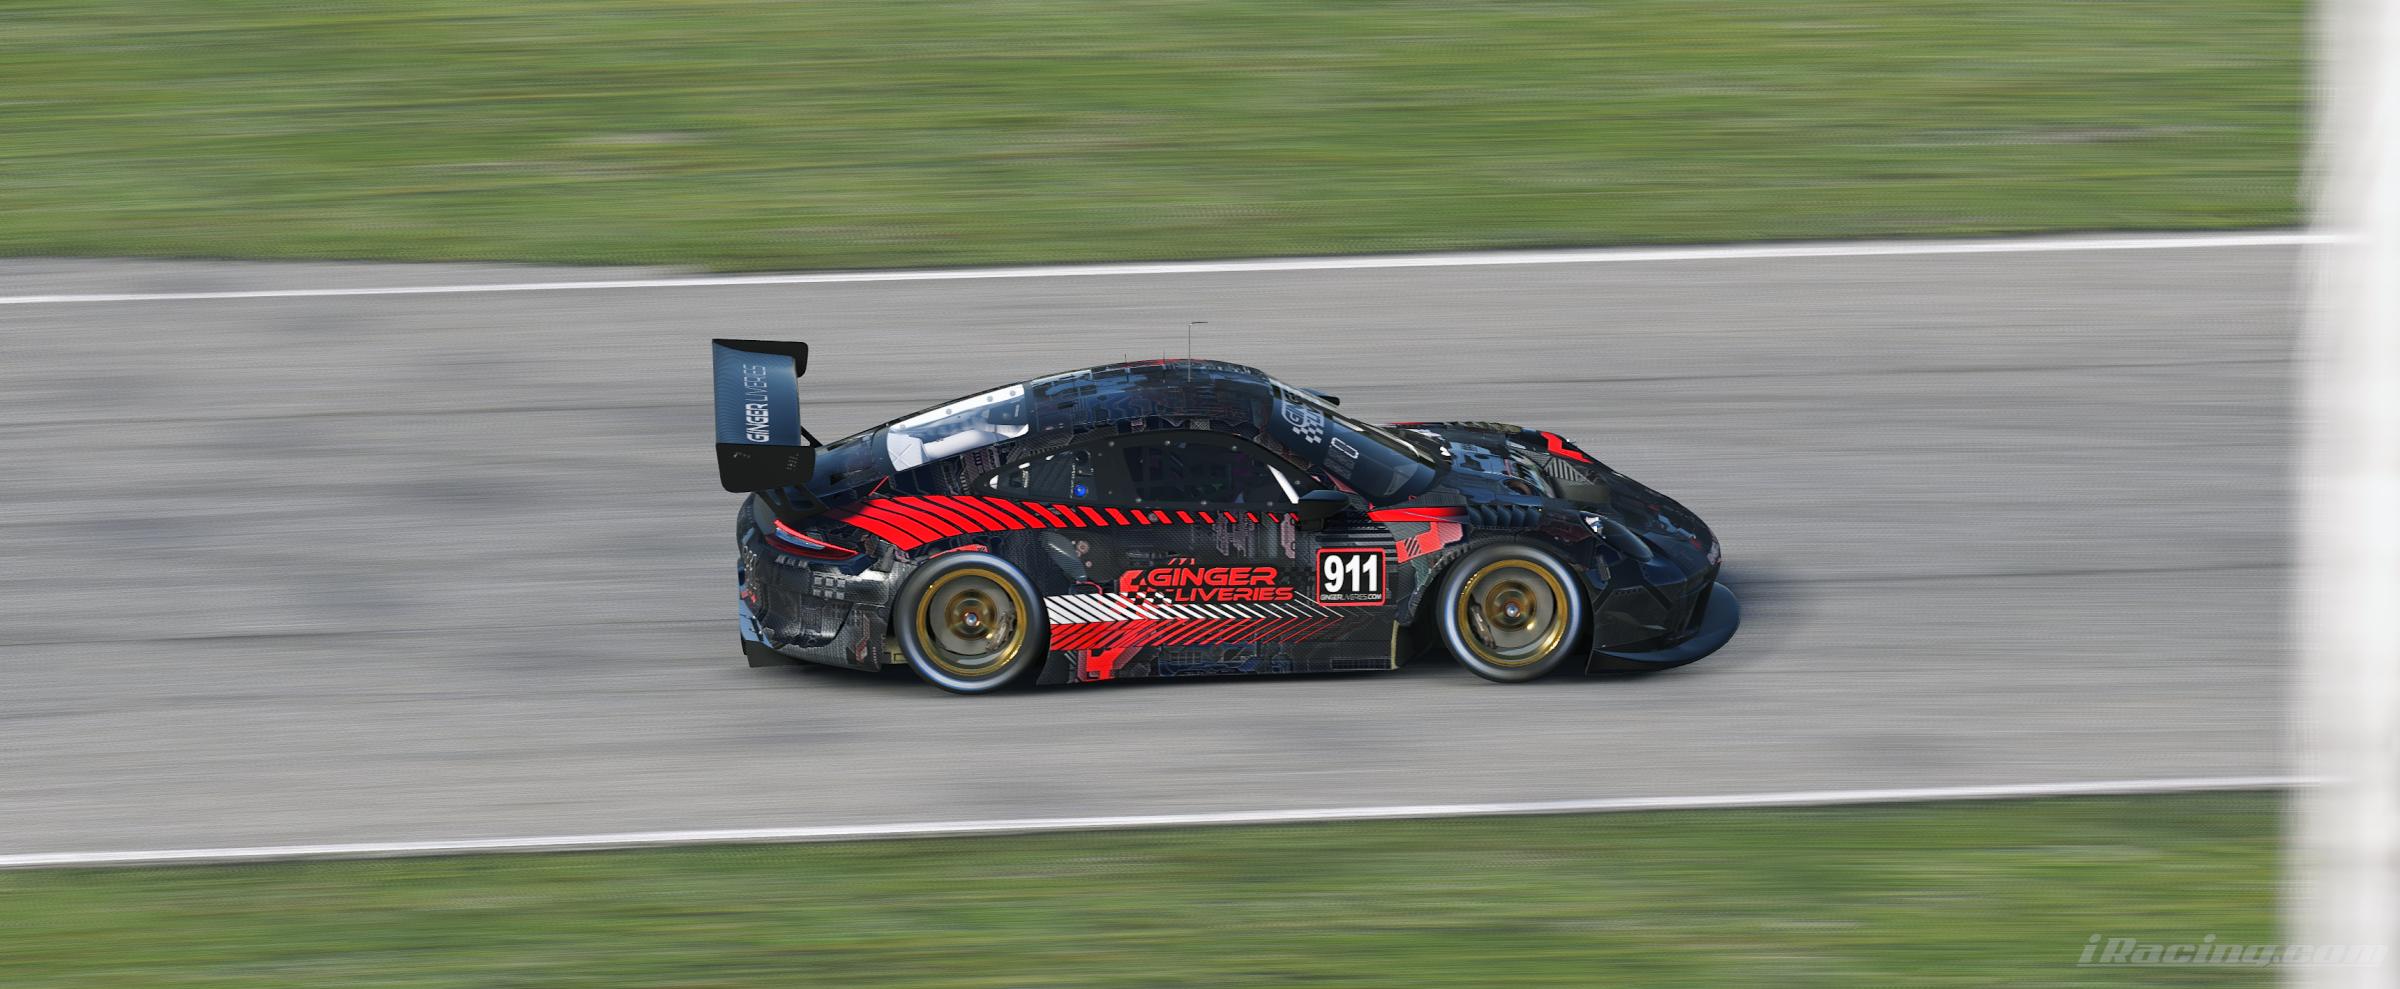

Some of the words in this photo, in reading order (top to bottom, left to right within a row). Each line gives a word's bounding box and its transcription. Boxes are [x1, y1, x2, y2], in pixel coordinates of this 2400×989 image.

[745, 403, 770, 443] GINGER
[1148, 567, 1278, 586] GINGER
[1324, 554, 1378, 593] 911
[1175, 587, 1294, 601] LIVERIES
